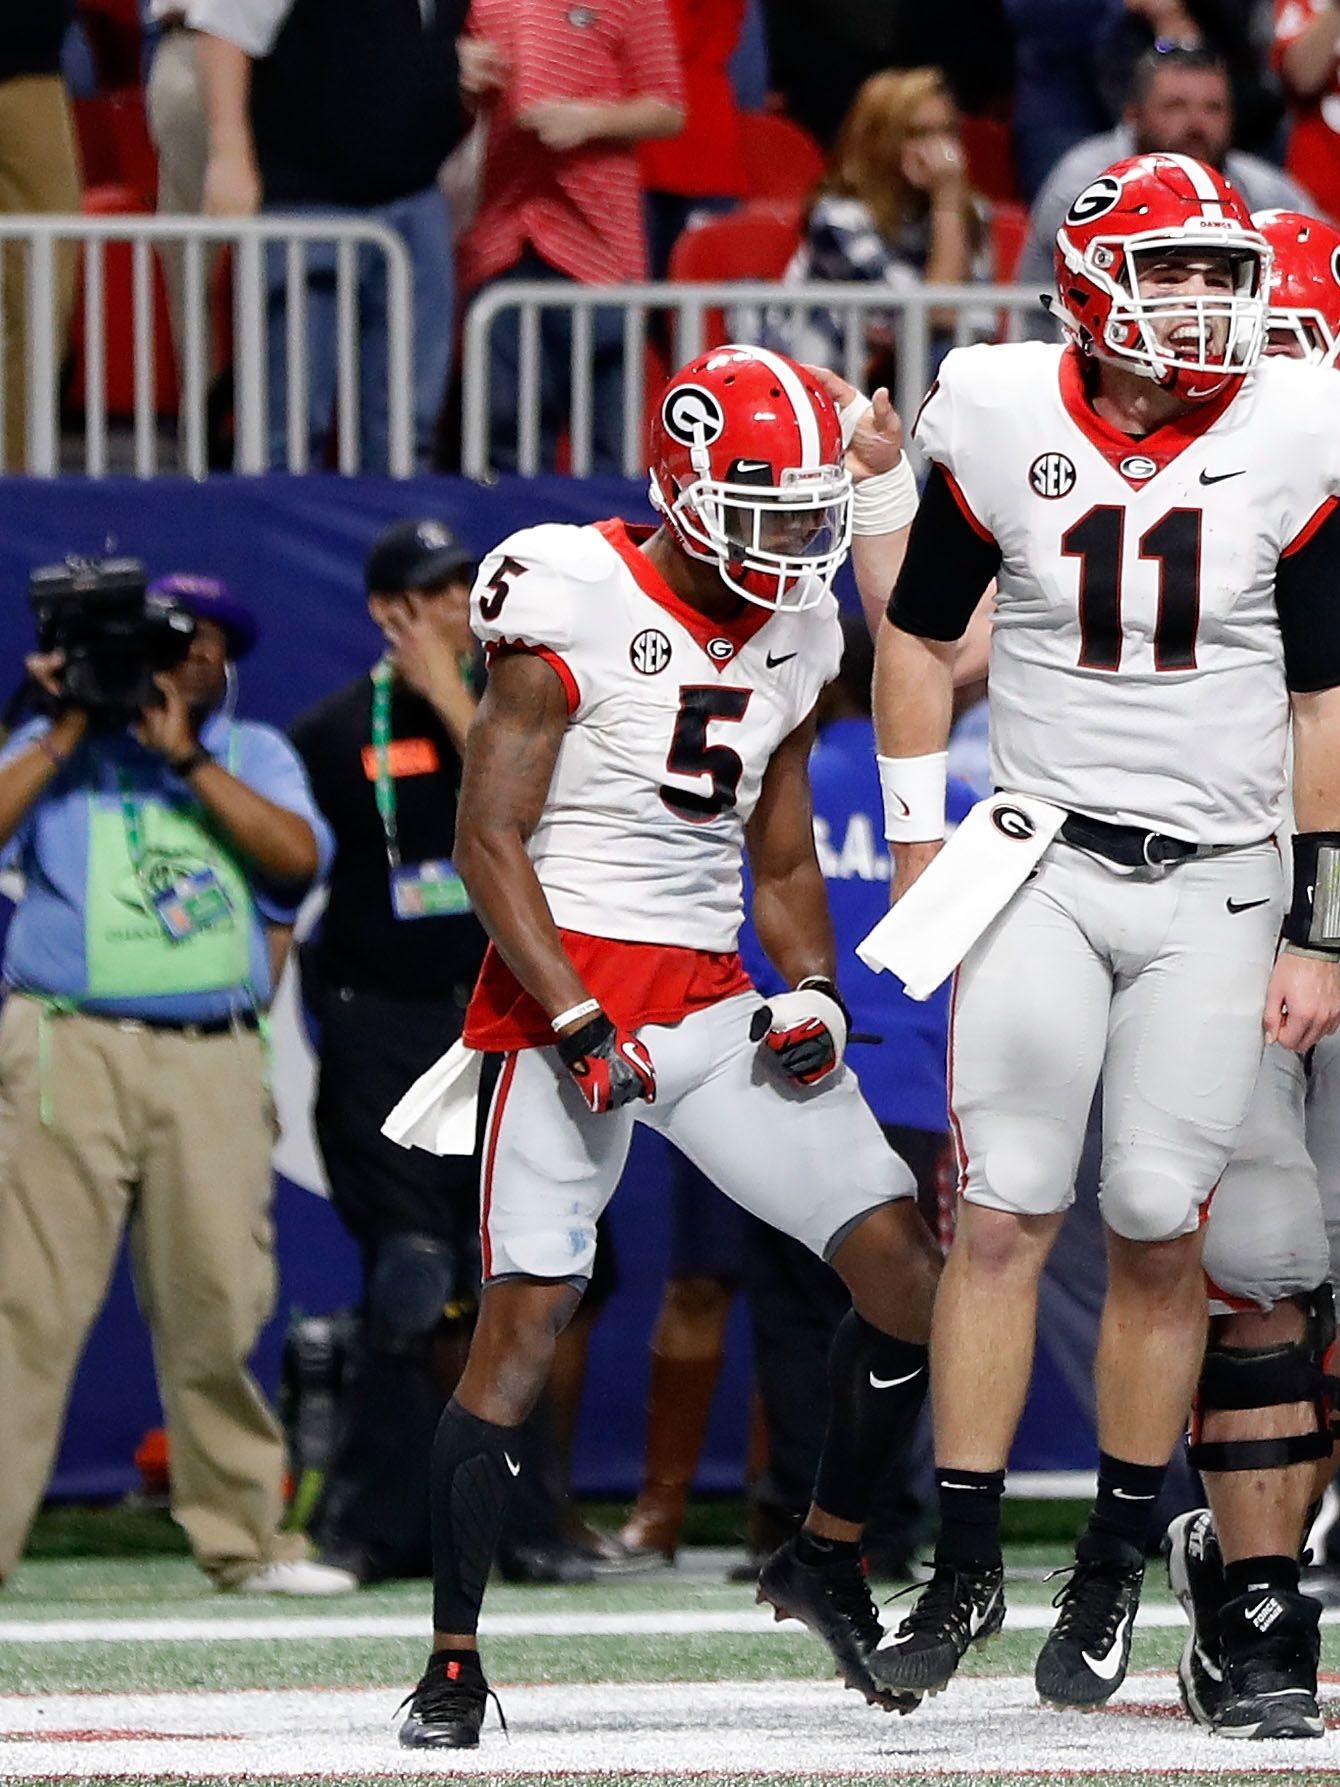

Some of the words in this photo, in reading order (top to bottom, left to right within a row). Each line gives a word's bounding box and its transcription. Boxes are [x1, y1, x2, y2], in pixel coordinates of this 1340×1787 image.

[1067, 177, 1121, 224] G
[1030, 454, 1075, 498] SEC
[479, 556, 529, 622] 5
[1060, 504, 1203, 673] 11
[630, 630, 671, 674] SEC
[659, 684, 754, 824] 5
[992, 806, 1036, 840] G
